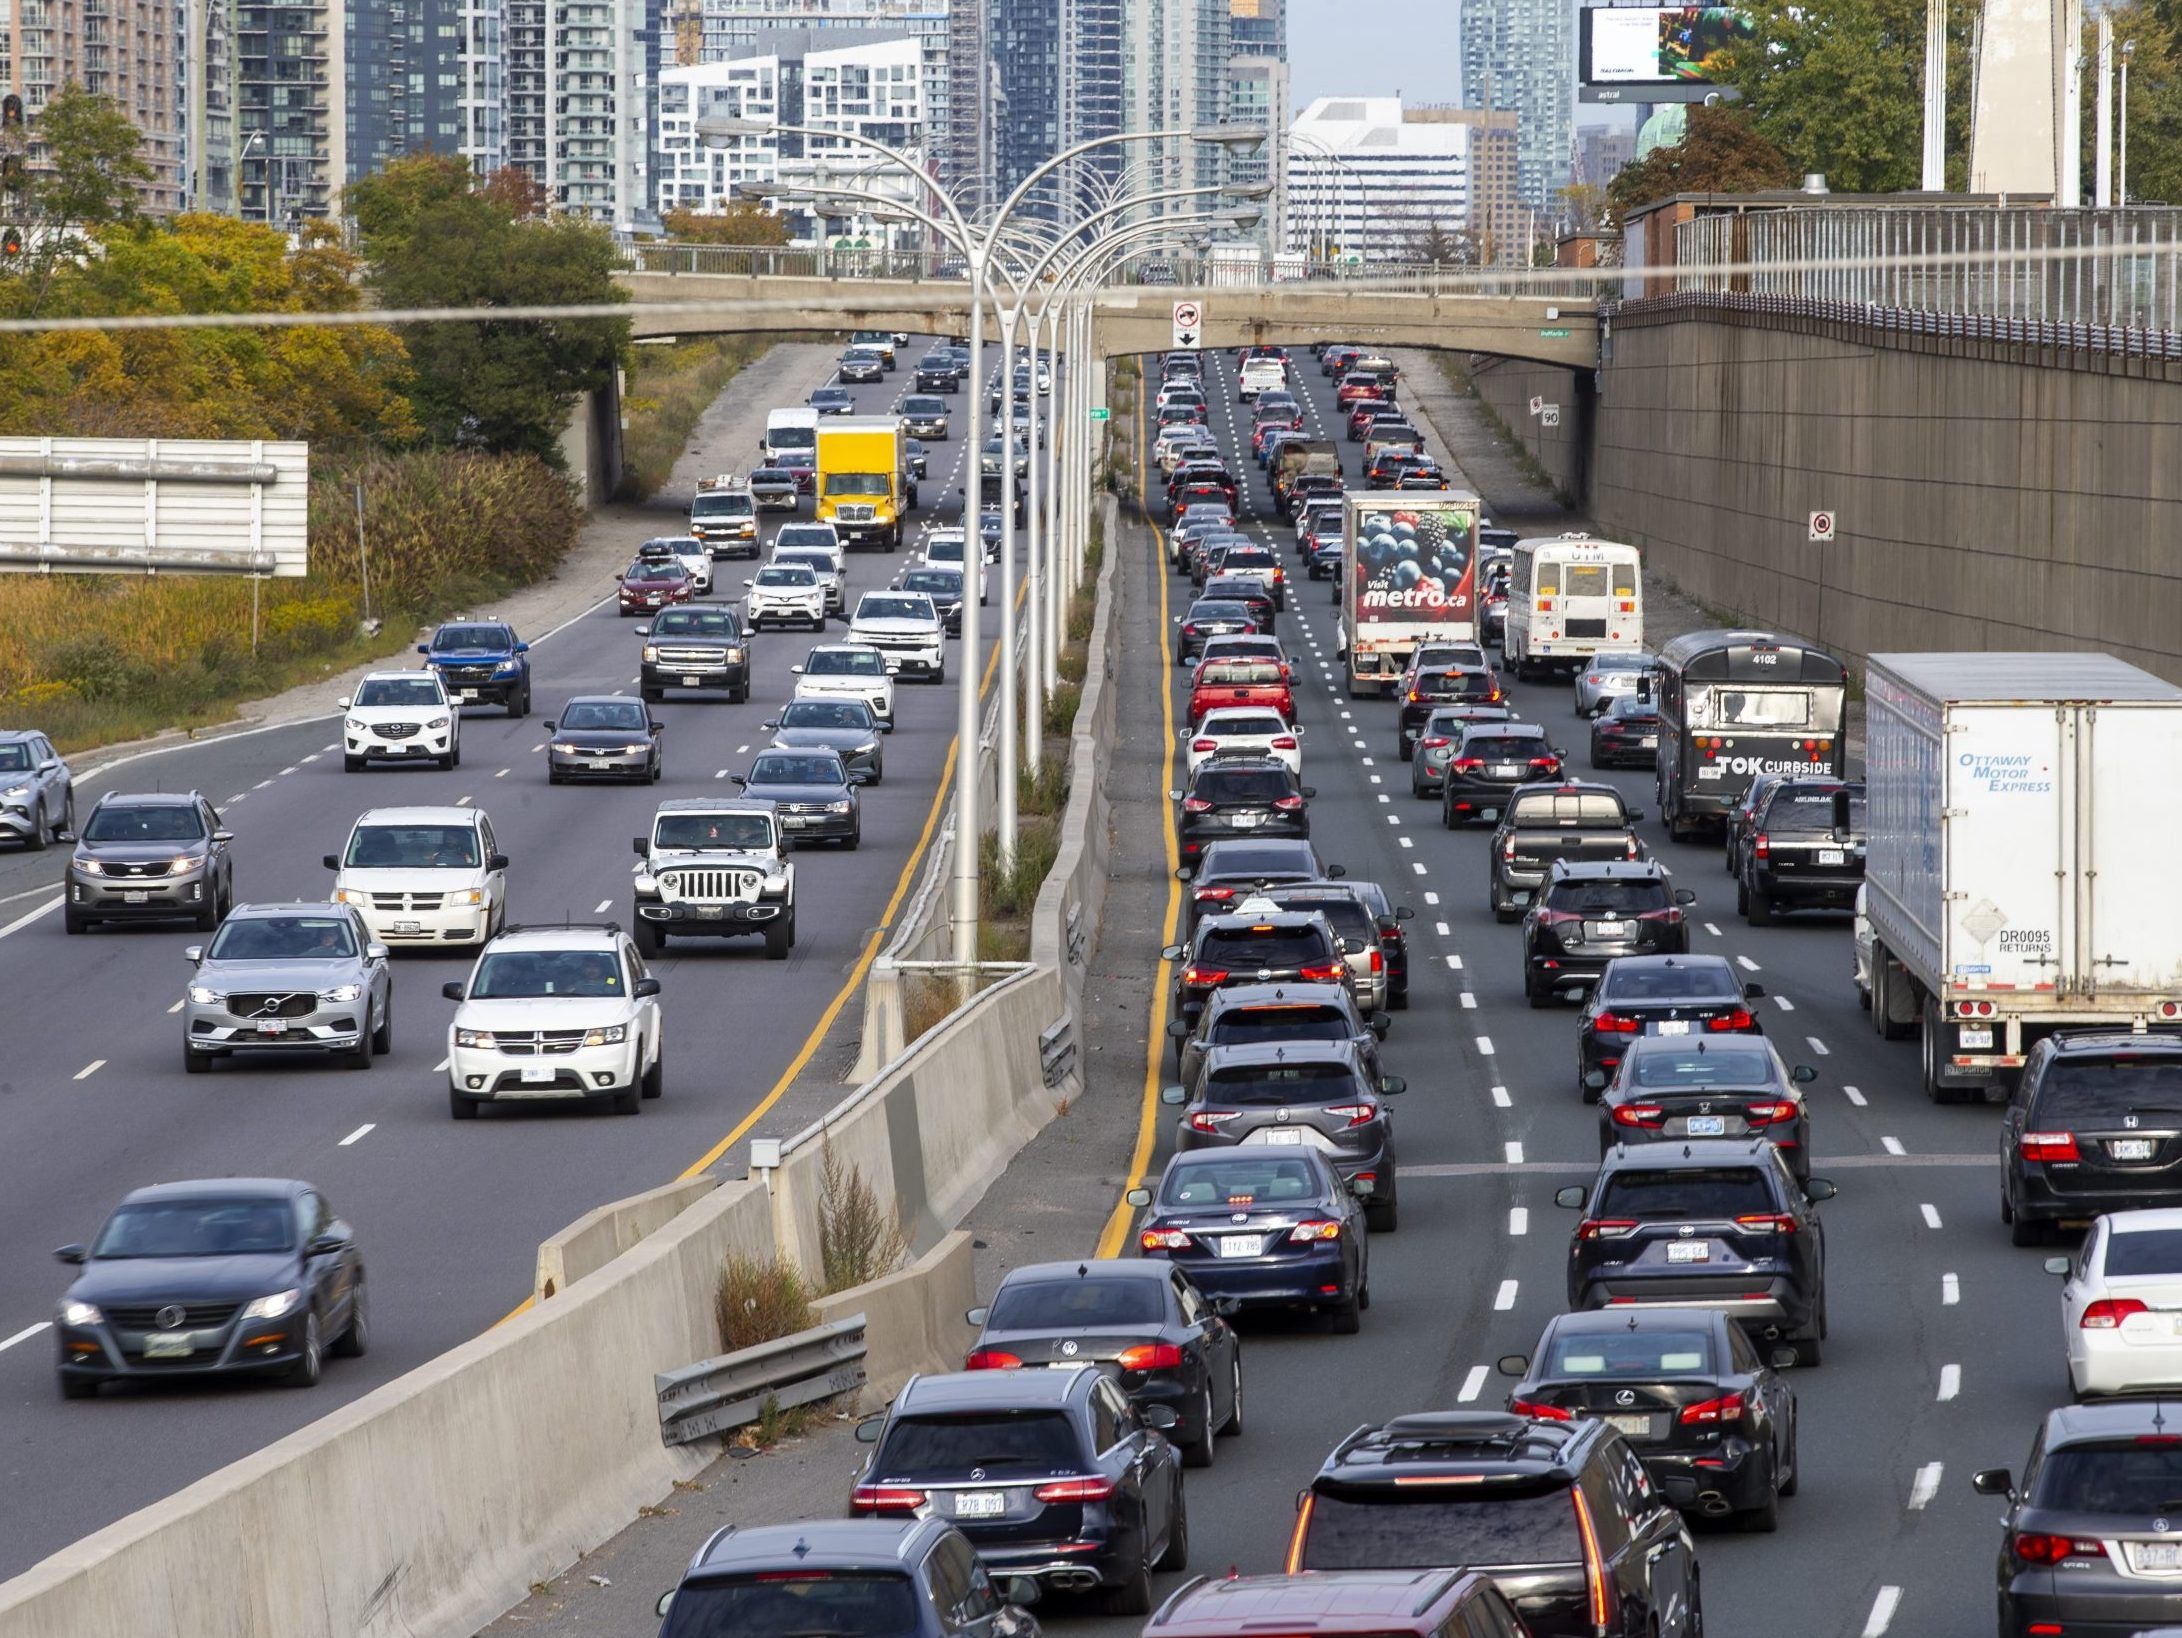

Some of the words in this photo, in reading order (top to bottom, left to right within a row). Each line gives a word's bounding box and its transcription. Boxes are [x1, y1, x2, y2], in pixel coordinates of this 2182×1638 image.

[1598, 90, 1620, 99] astral
[1545, 413, 1557, 423] 90
[1367, 580, 1389, 590] Visit
[1363, 588, 1467, 607] metro.ca
[1752, 655, 1777, 665] 4102
[1716, 756, 1764, 775] TOK
[1765, 760, 1832, 775] CURBSIDE
[1959, 753, 2032, 766] OTTAWAY
[1973, 766, 2029, 779] MOTOR
[1989, 780, 2052, 792] EXPRESS
[2000, 930, 2050, 943] DR0095
[2000, 944, 2051, 952] RETURNS
